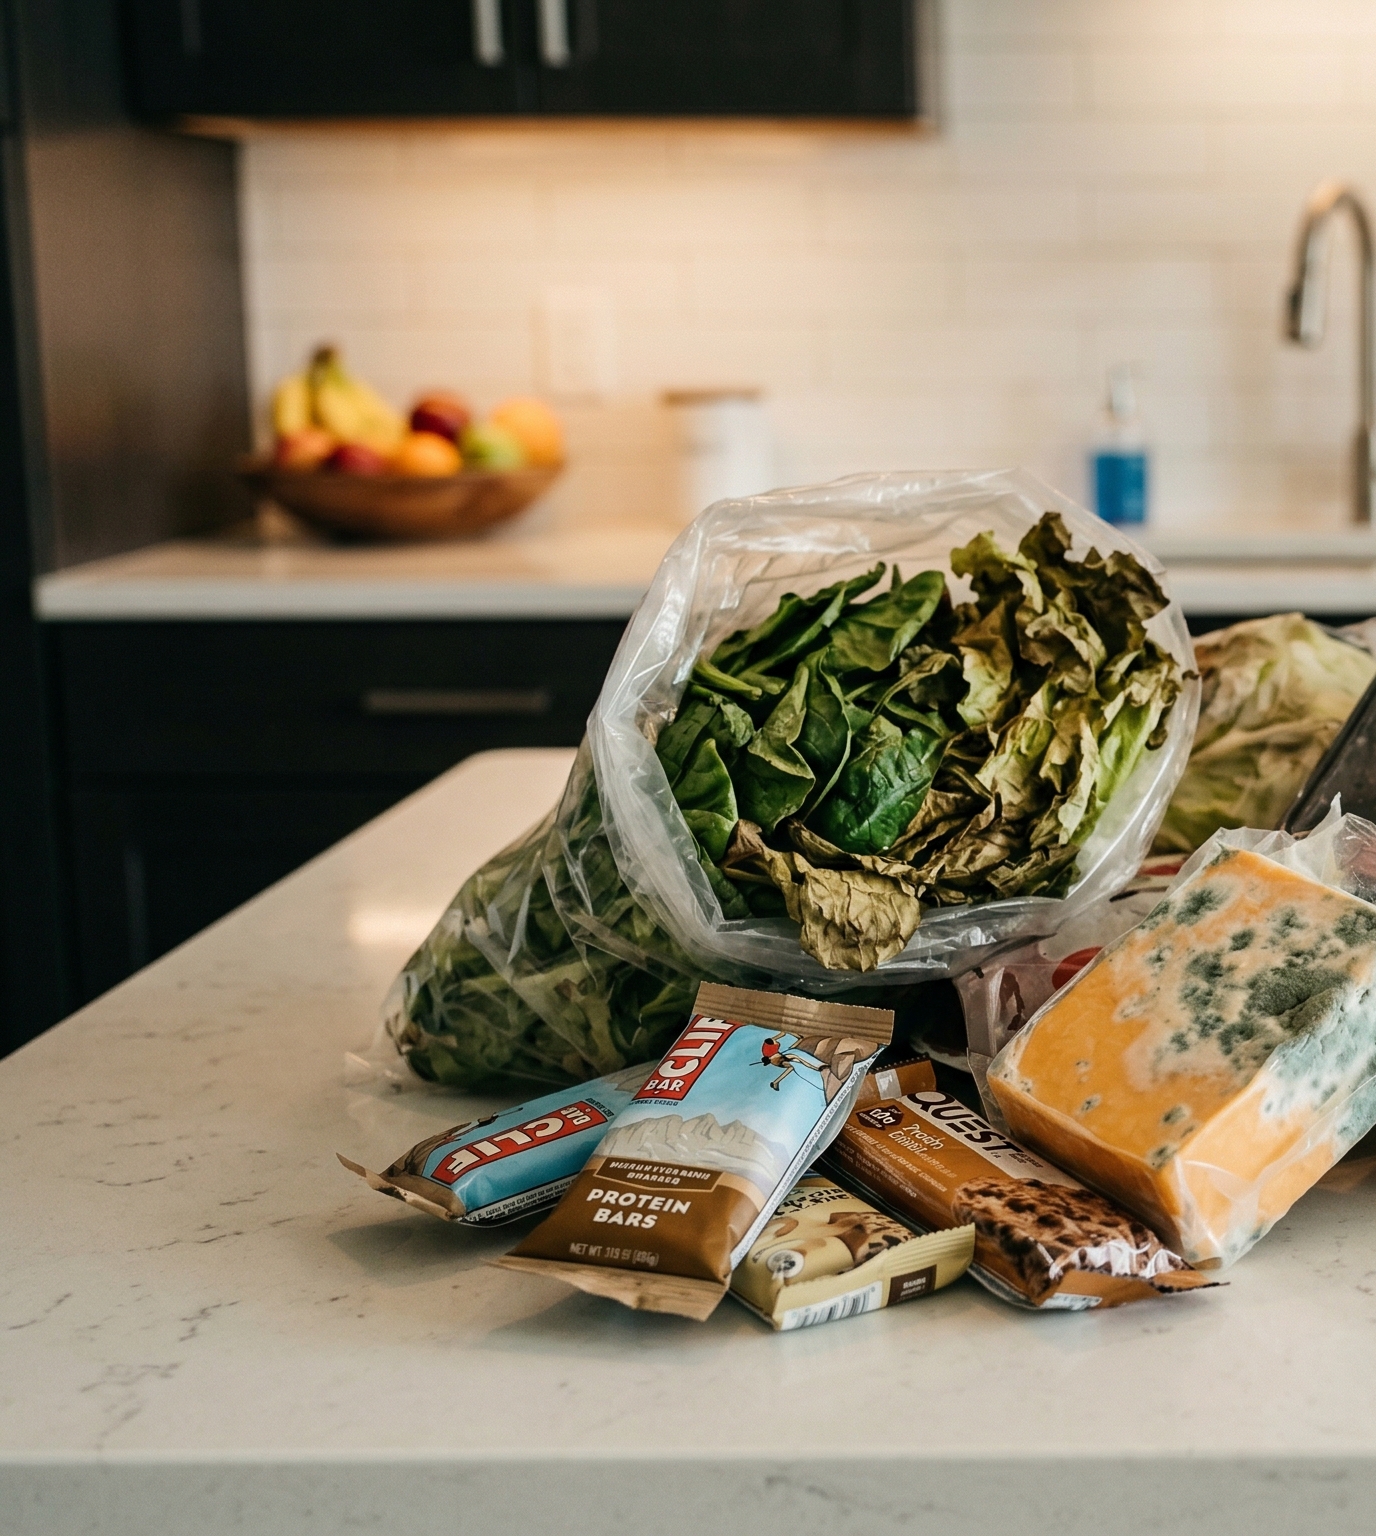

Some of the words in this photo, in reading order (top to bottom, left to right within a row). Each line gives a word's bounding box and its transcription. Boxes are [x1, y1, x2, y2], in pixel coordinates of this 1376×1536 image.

[658, 1017, 734, 1078] CLIF
[644, 1079, 685, 1093] BAR
[907, 1090, 1024, 1153] QUEST
[446, 1117, 564, 1175] CLIF
[586, 1188, 692, 1215] PROTEIN
[593, 1208, 658, 1229] BARS
